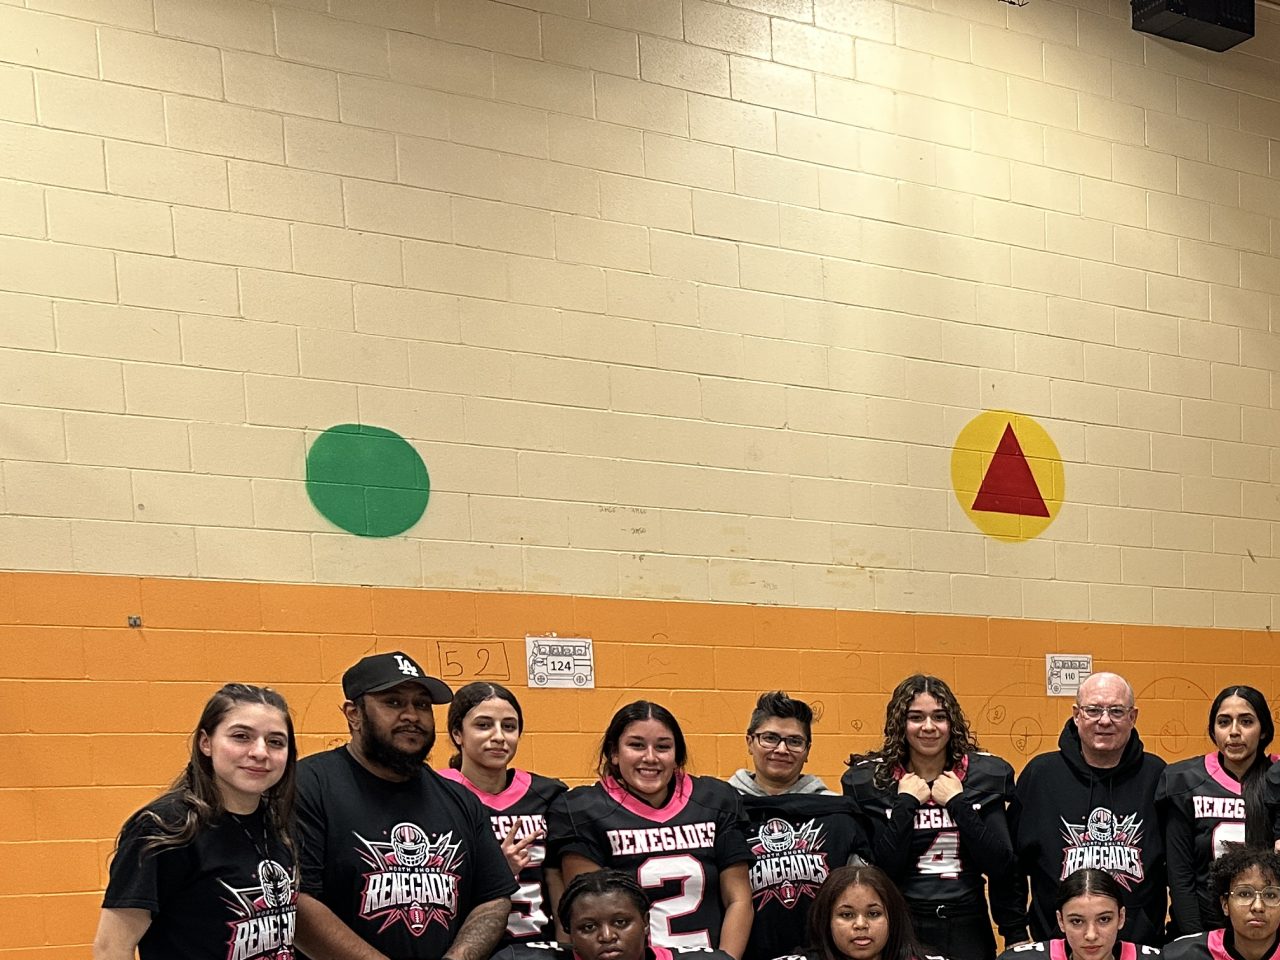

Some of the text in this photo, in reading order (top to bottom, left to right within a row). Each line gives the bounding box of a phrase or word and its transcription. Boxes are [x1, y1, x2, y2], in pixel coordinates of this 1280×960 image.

[550, 660, 572, 672] 124
[607, 821, 716, 856] RENEGADES
[917, 830, 963, 879] 4
[1064, 845, 1141, 879] RENEGADES
[363, 872, 458, 916] RENEGADES
[638, 854, 712, 949] 2
